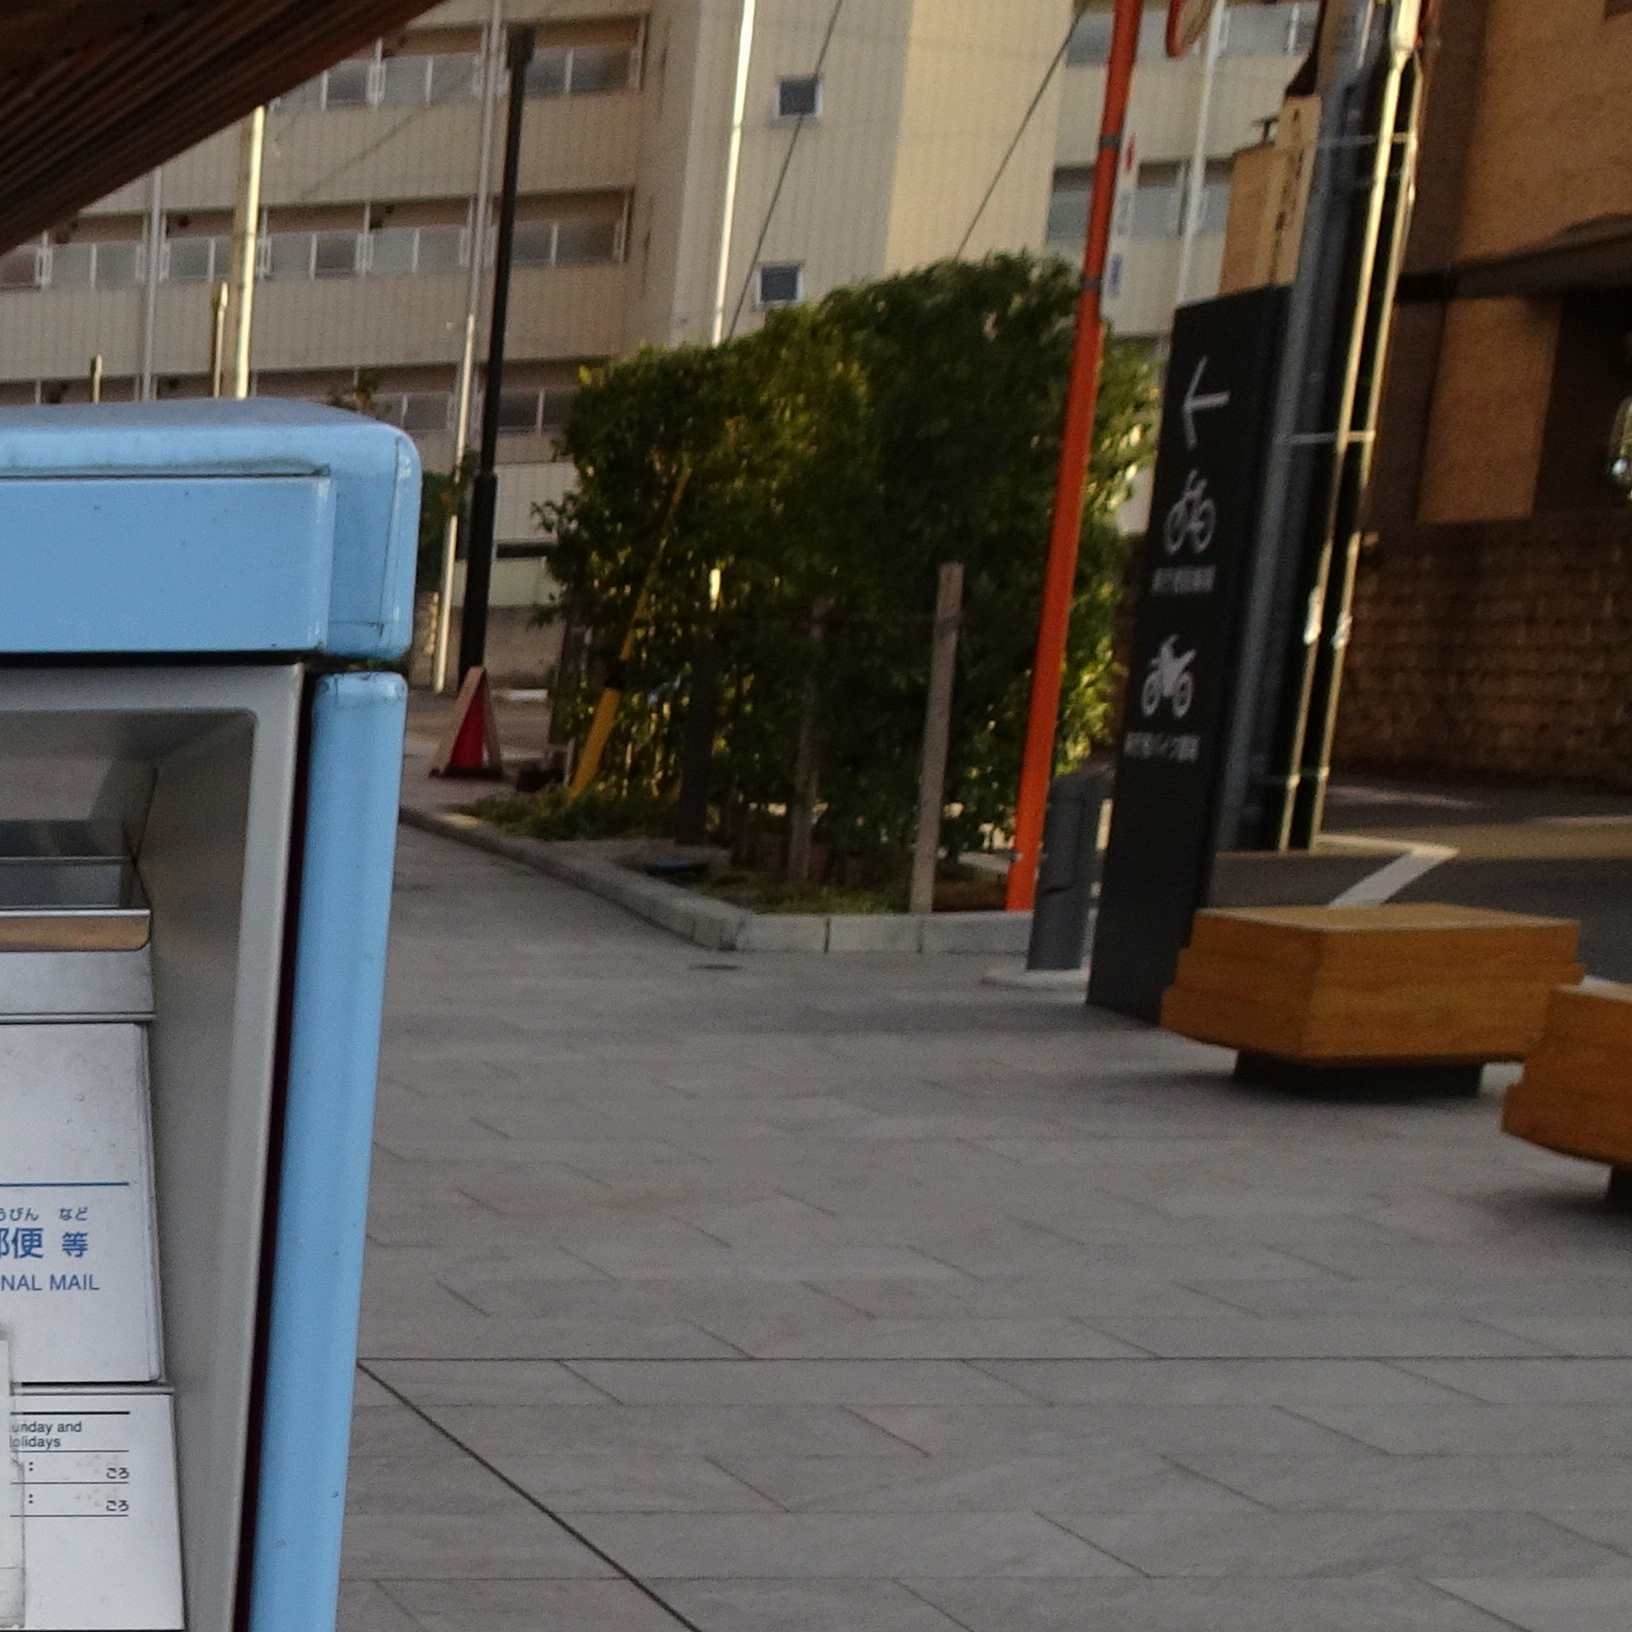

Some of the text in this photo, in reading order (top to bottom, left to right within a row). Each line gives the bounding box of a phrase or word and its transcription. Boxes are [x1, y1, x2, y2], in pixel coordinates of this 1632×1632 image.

[49, 1273, 100, 1291] MAIL
[10, 1421, 83, 1435] unday and
[9, 1435, 62, 1449] olidays
